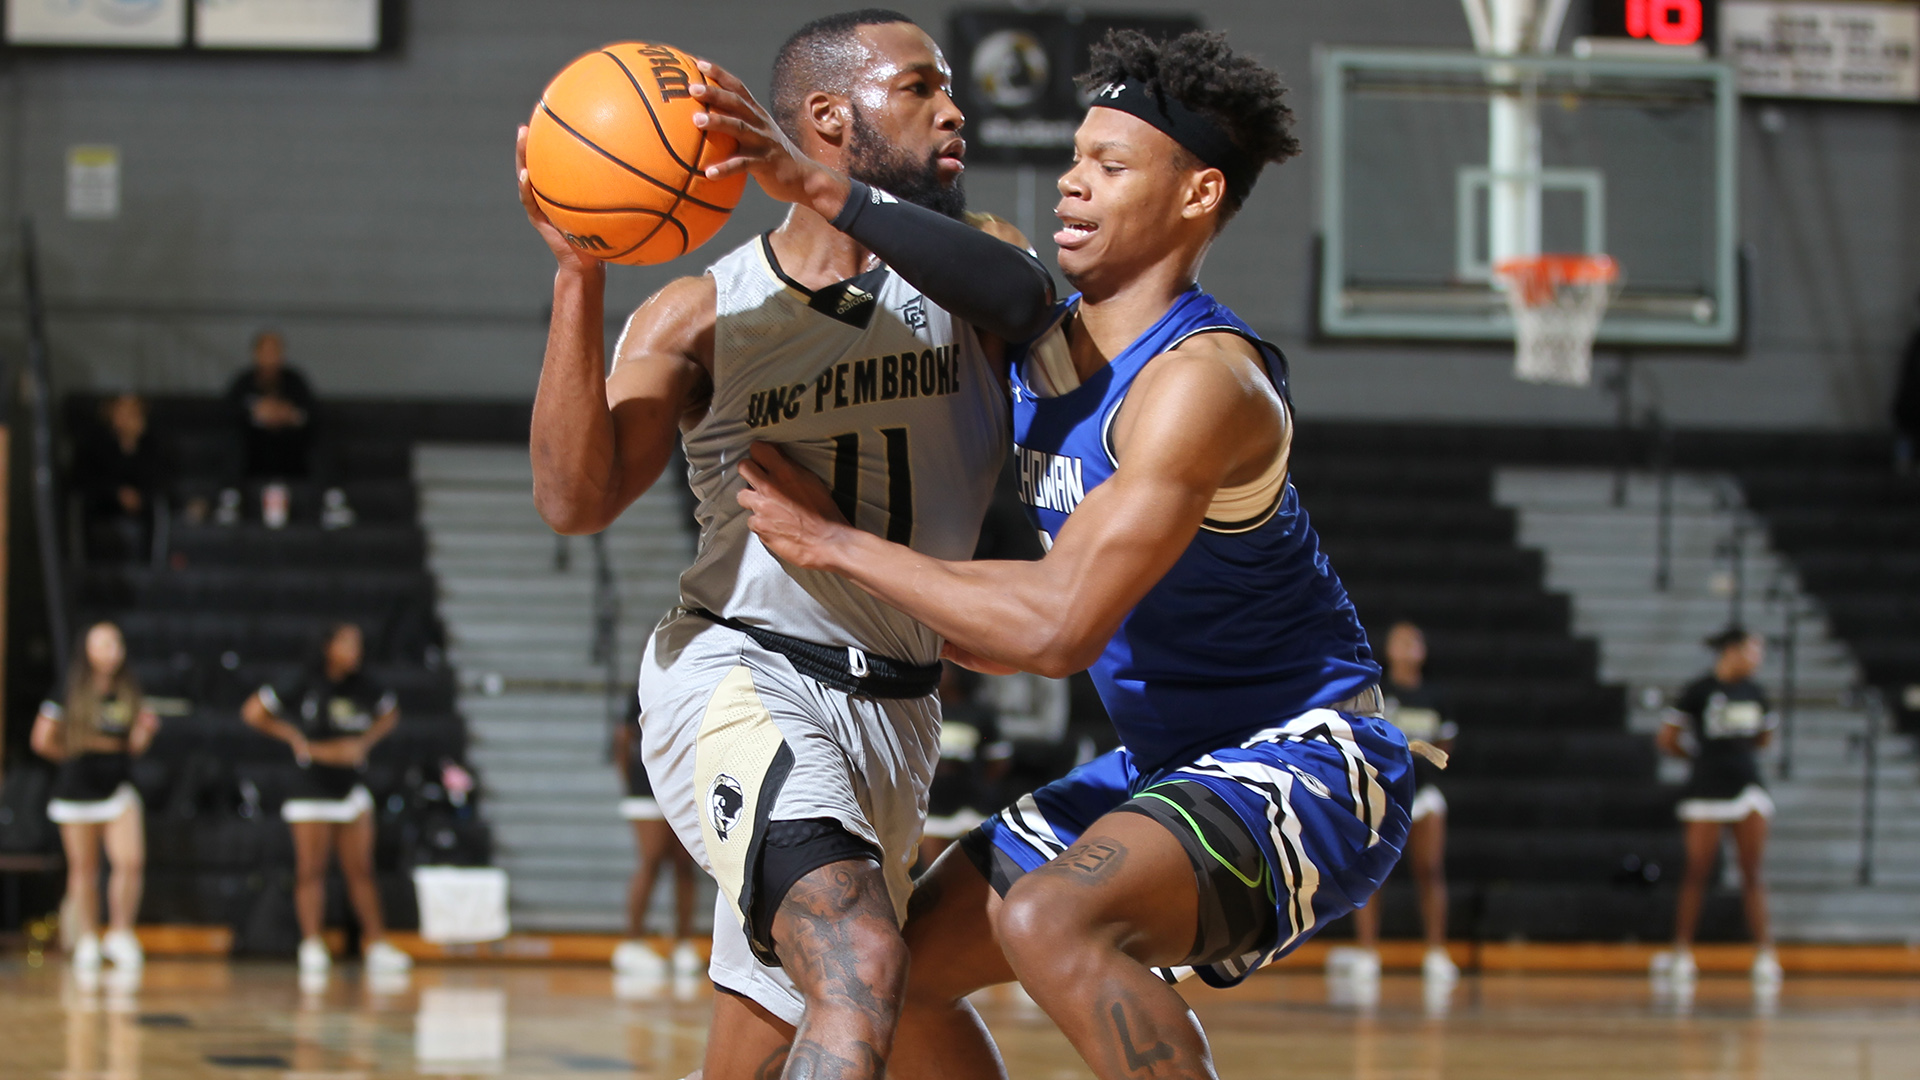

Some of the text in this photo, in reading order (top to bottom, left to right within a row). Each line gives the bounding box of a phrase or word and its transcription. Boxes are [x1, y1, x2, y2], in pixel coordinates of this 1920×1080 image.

[836, 292, 874, 315] adidas
[745, 343, 961, 429] UNC PEMBROKE
[831, 427, 913, 547] 11
